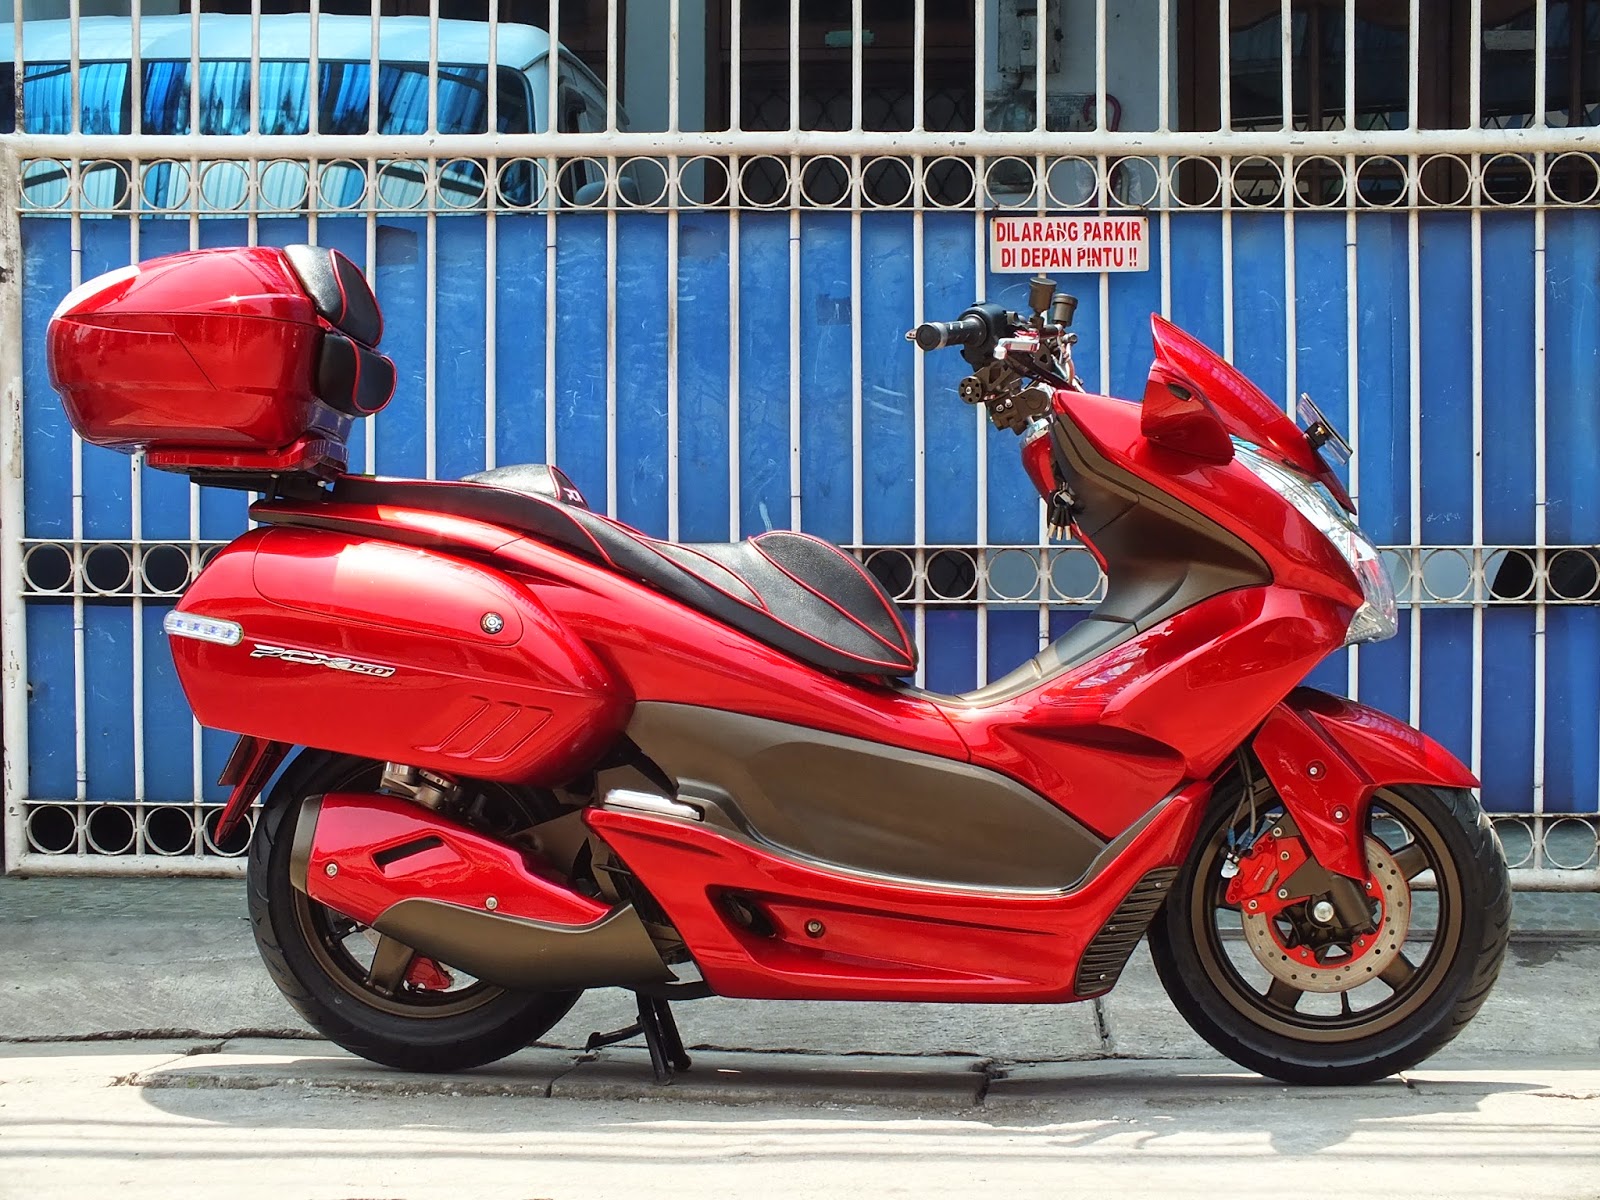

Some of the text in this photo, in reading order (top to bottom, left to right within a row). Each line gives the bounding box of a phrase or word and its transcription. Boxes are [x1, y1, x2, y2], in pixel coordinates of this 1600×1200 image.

[996, 221, 1142, 242] DILARANG PARKIR
[1001, 248, 1017, 268] DI
[1021, 247, 1072, 268] DEPAN
[1077, 247, 1124, 267] PINTU
